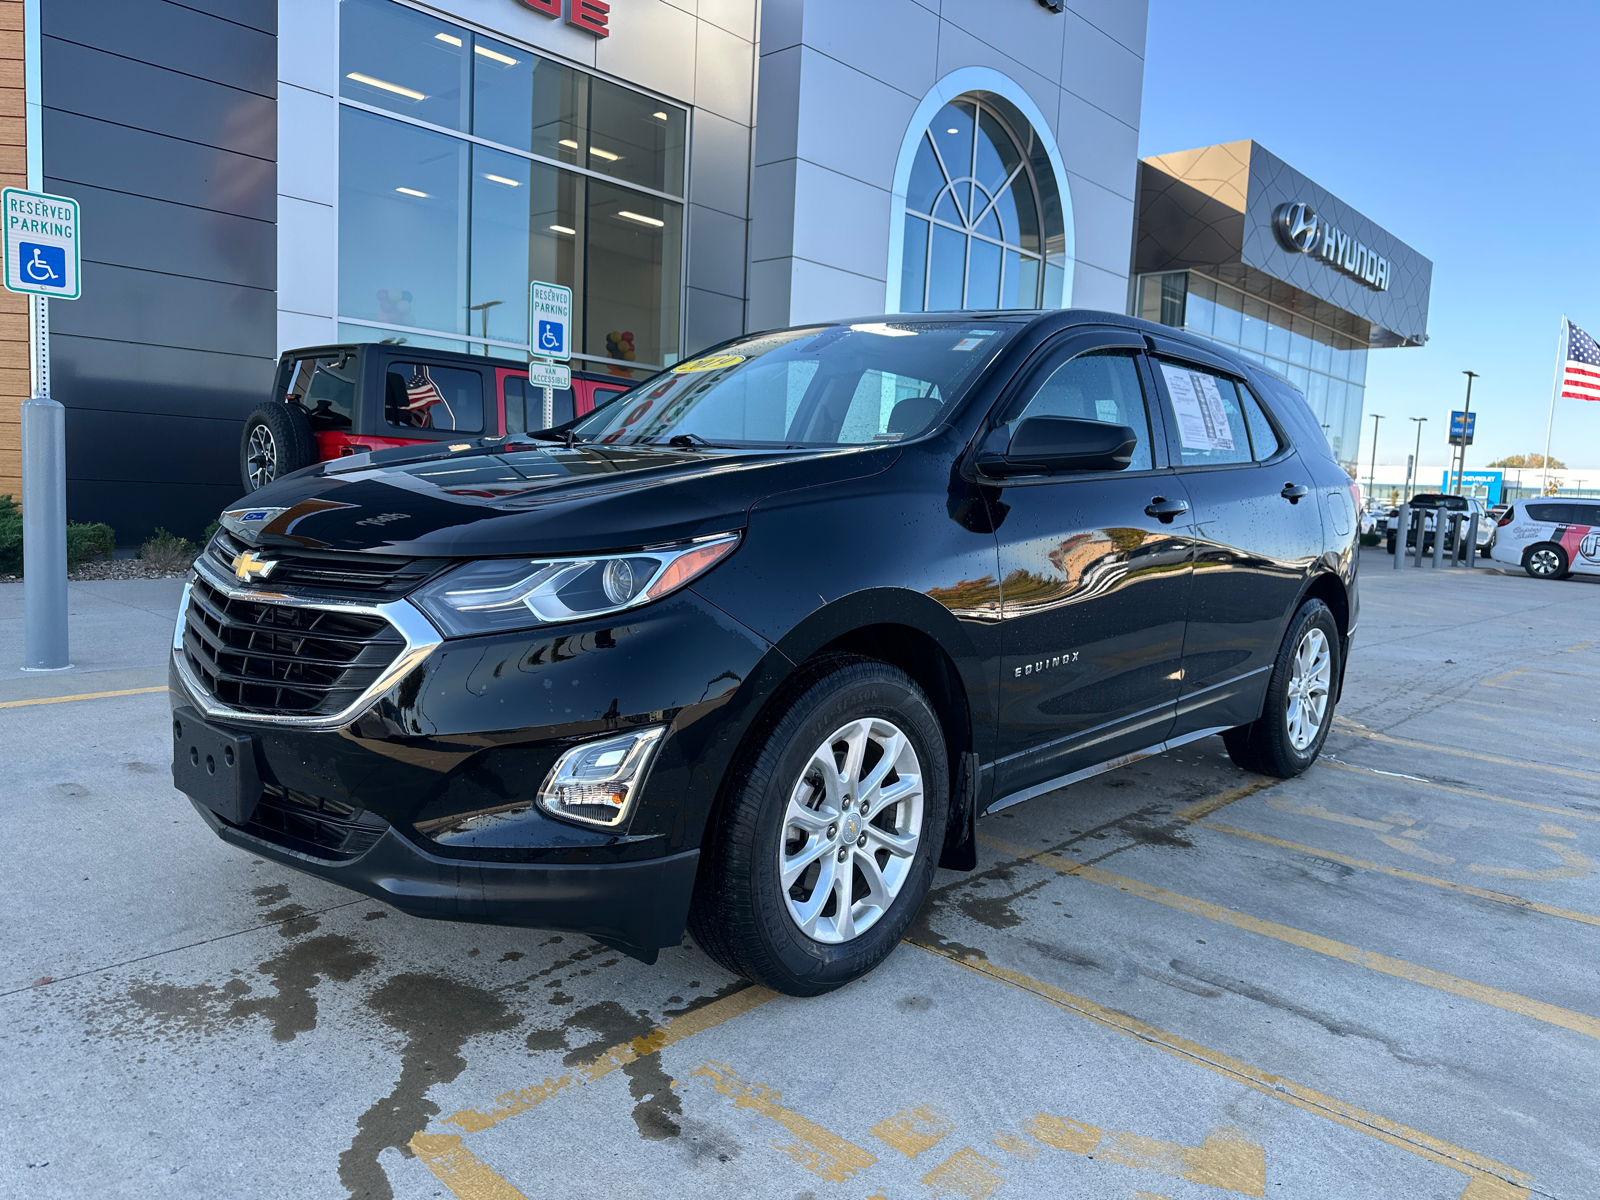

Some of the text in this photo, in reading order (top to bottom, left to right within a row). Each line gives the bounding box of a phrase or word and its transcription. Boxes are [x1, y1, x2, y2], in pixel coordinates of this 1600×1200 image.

[10, 198, 72, 221] RESERVED
[10, 216, 73, 238] PARKING
[1321, 222, 1391, 291] HYUNDAI
[535, 288, 568, 304] RESERVED
[534, 302, 568, 316] PARKING
[533, 374, 567, 385] ACCESSIBLE
[545, 367, 557, 375] VAN
[1014, 651, 1079, 678] EQUINOX
